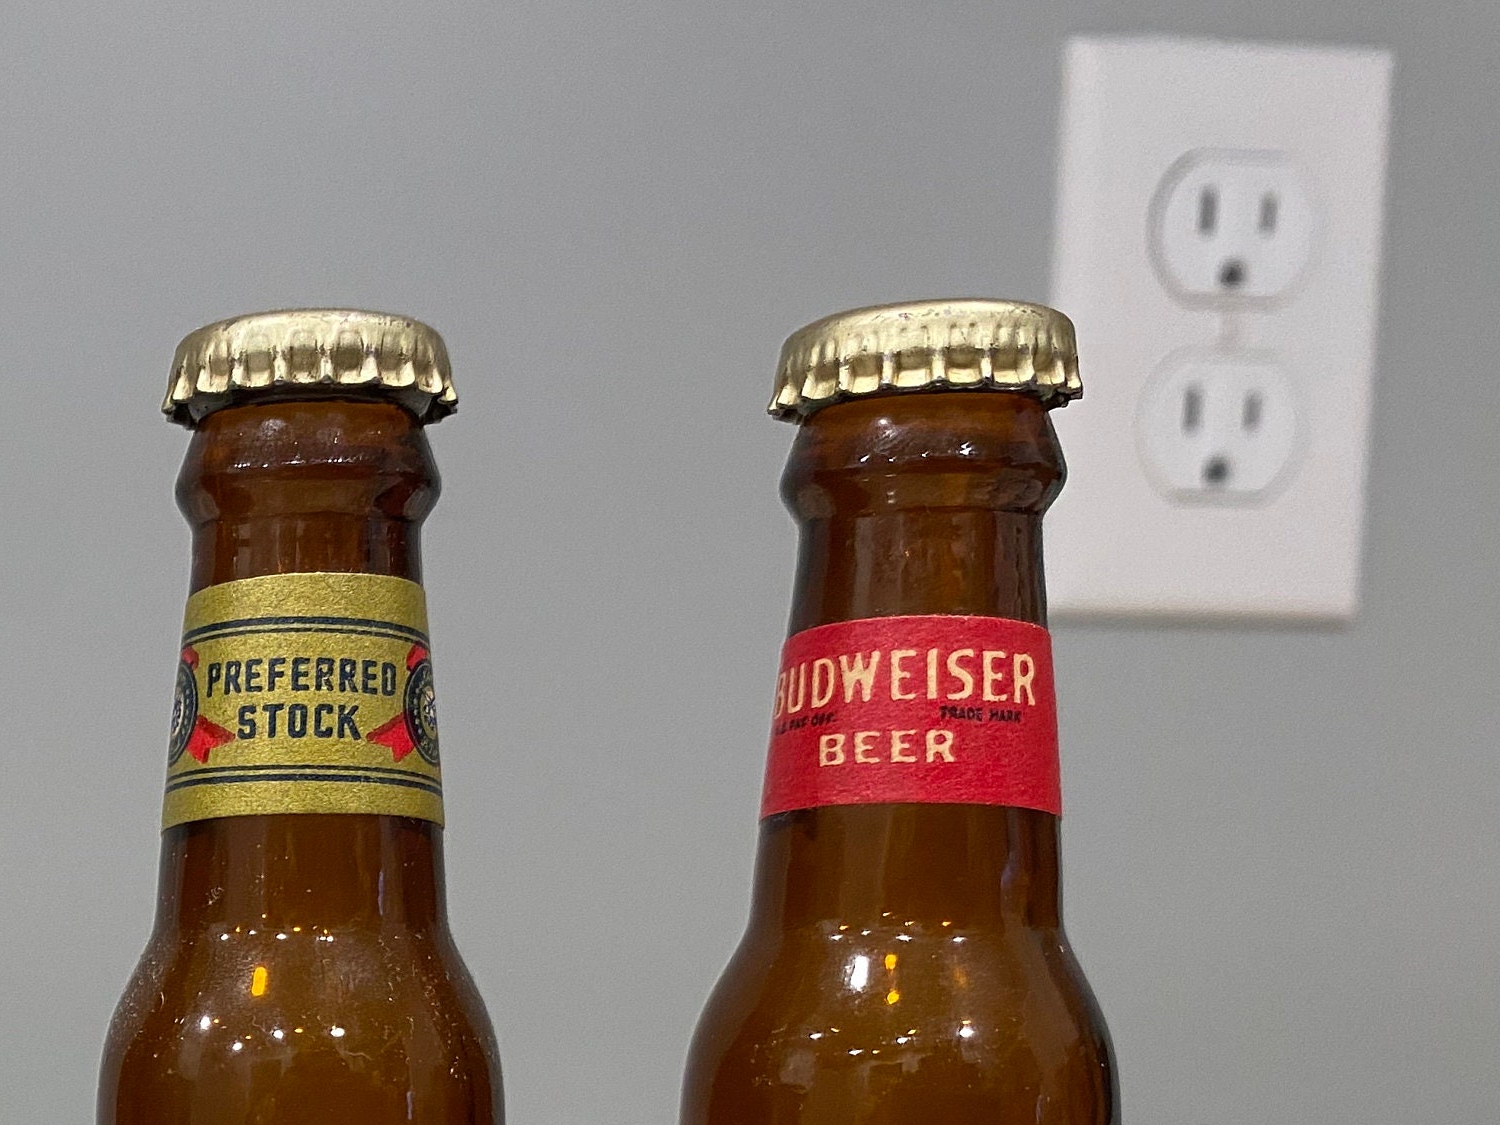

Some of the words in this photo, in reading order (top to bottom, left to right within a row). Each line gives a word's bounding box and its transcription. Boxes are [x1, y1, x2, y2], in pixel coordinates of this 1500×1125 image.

[206, 656, 398, 698] PREFERRED
[773, 648, 1036, 719] BUDWEISER
[236, 703, 362, 741] STOCK
[819, 728, 955, 767] BEER
